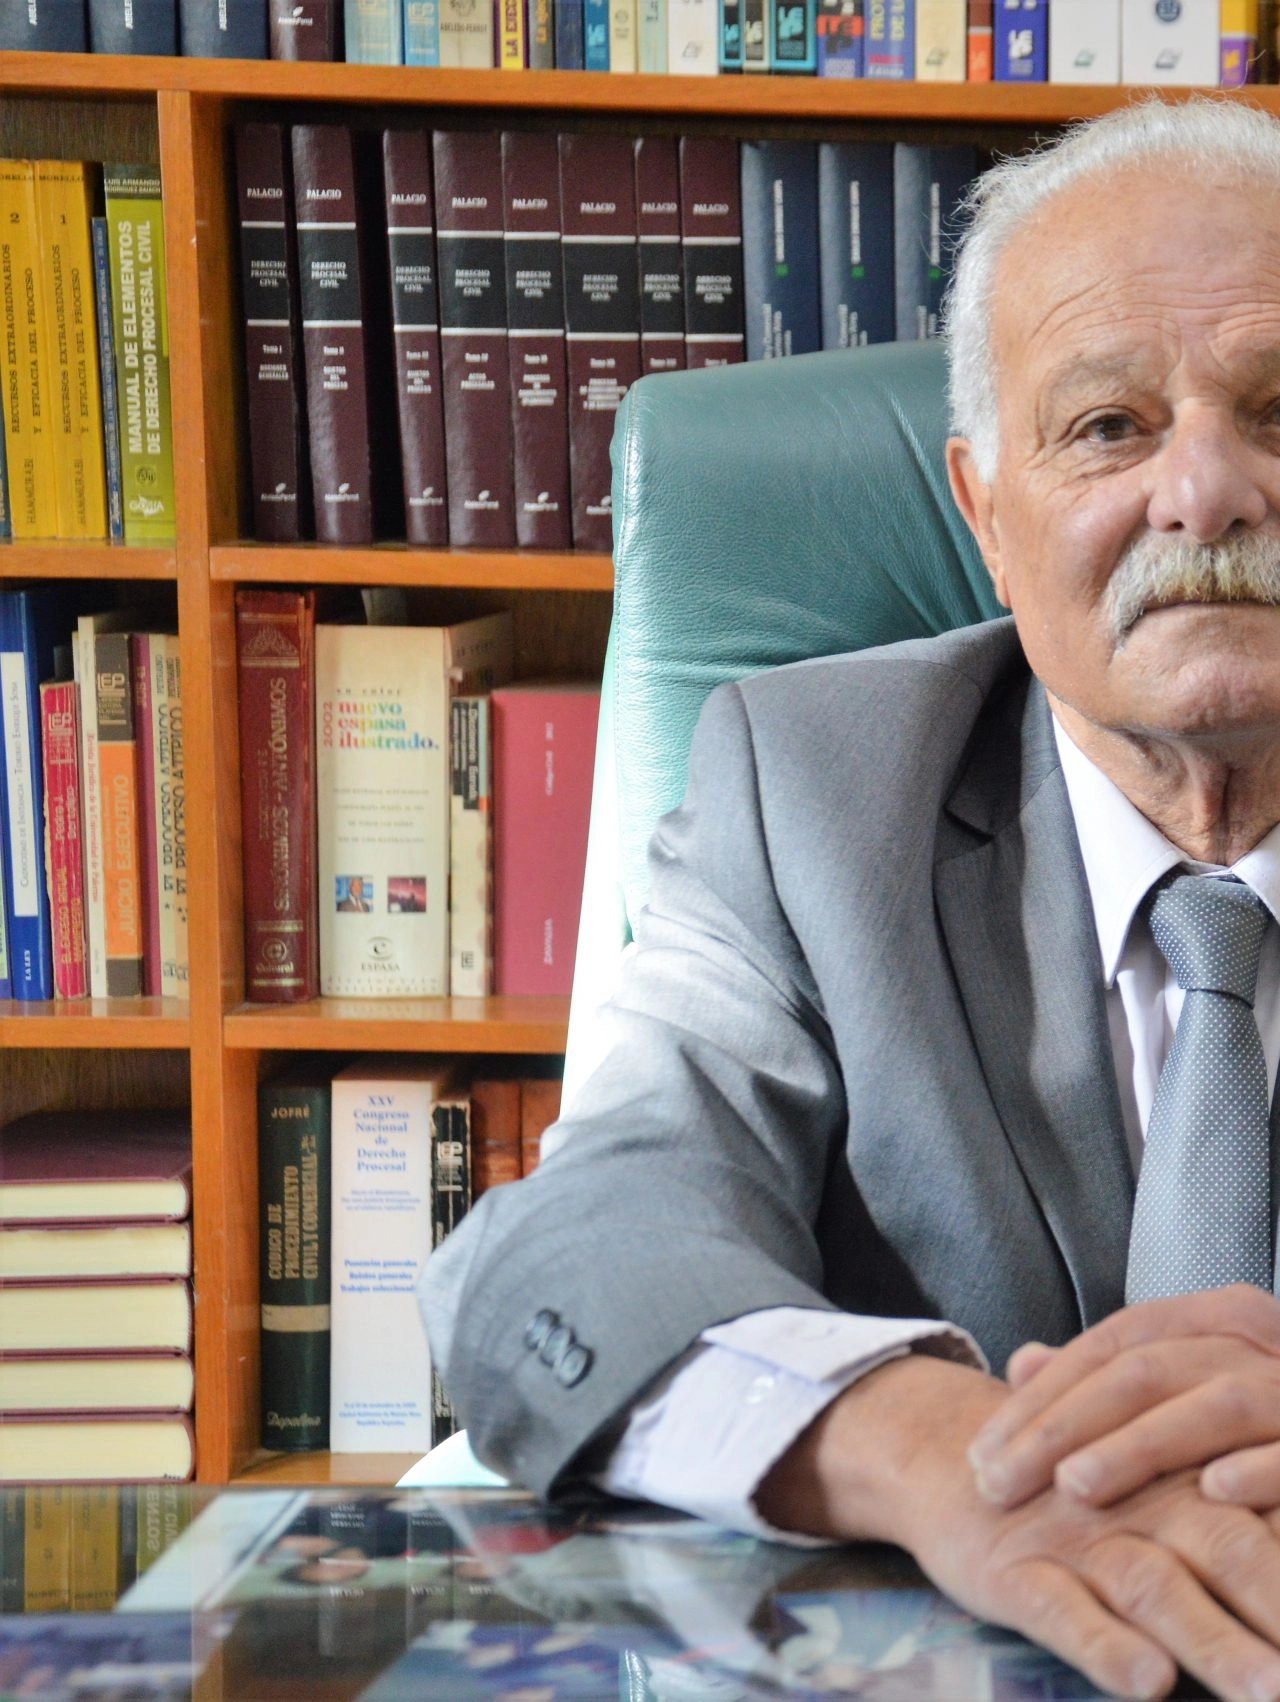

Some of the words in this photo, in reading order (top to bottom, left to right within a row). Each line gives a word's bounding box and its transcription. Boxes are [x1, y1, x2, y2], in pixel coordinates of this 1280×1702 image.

[506, 38, 518, 57] LA
[122, 178, 160, 186] ARMANDO
[247, 188, 282, 198] PALACIO
[306, 189, 341, 199] PALACIO
[391, 194, 426, 204] PALACIO
[452, 197, 487, 208] PALACIO
[512, 198, 548, 209] PALACIO
[580, 203, 616, 214] PALACIO
[641, 203, 677, 213] PALACIO
[693, 203, 729, 214] PALACIO
[10, 213, 20, 224] 2
[60, 214, 66, 224] 1
[137, 220, 152, 263] CIVIL
[251, 260, 286, 269] DERECHO
[311, 262, 346, 270] DERECHO
[396, 266, 430, 274] DERECHO
[119, 220, 138, 338] ELEMENTOS
[251, 270, 287, 278] PROCESAL
[311, 270, 347, 279] PROCESAL
[395, 274, 431, 283] PROCESAL
[455, 269, 490, 278] DERECHO
[516, 270, 551, 279] DERECHO
[583, 274, 618, 282] DERECHO
[644, 273, 680, 283] DERECHO
[260, 279, 279, 287] CIVIL
[320, 279, 339, 288] CIVIL
[455, 278, 491, 287] PROCESAL
[516, 279, 551, 288] PROCESAL
[697, 275, 732, 284] DERECHO
[404, 284, 423, 293] CIVIL
[463, 287, 482, 297] CIVIL
[524, 288, 543, 297] CIVIL
[582, 283, 618, 292] PROCESAL
[644, 283, 680, 292] PROCESAL
[696, 284, 732, 293] PROCESAL
[24, 268, 35, 324] PROCESO
[72, 268, 82, 325] PROCESO
[591, 292, 610, 301] CIVIL
[653, 292, 672, 301] CIVIL
[704, 293, 724, 303] CIVIL
[2, 244, 17, 365] EXTRAORDINARIOS
[52, 245, 68, 365] EXTRAORDINARIOS
[139, 267, 156, 350] PROCESAL
[27, 332, 37, 354] DEL
[75, 332, 85, 354] DEL
[124, 342, 139, 368] DE
[29, 359, 40, 417] EFICACIA
[77, 360, 88, 417] EFICACIA
[143, 354, 159, 429] DERECHO
[9, 370, 20, 433] RECURSOS
[61, 370, 72, 433] RECURSOS
[126, 373, 142, 453] MANUAL
[146, 433, 160, 454] DE
[338, 701, 403, 715] nuevo
[323, 701, 333, 748] 2002
[338, 717, 406, 733] espasa
[268, 677, 288, 790] ANTÓNIMOS
[339, 731, 439, 750] ilustrado.
[65, 785, 77, 839] Bertolino
[54, 804, 65, 840] Pedro
[113, 775, 131, 871] EJECUTIVO
[56, 867, 68, 903] RITUAL
[118, 878, 136, 936] JUICIO
[59, 907, 71, 950] EXCESO
[71, 898, 82, 962] MANIFIESTO
[361, 963, 400, 972] ESPASA
[24, 969, 32, 981] LA
[368, 1096, 394, 1106] XXV
[271, 1104, 310, 1119] JOFRÉ
[354, 1109, 410, 1121] Congreso
[356, 1123, 408, 1133] Nacional
[375, 1135, 388, 1145] de
[357, 1148, 406, 1158] Derecho
[357, 1161, 406, 1172] Procesal
[302, 1154, 317, 1231] COMERCIAL
[268, 1204, 282, 1223] DE
[284, 1166, 299, 1278] PROCEDIMIENTO
[268, 1229, 282, 1280] CODIGO
